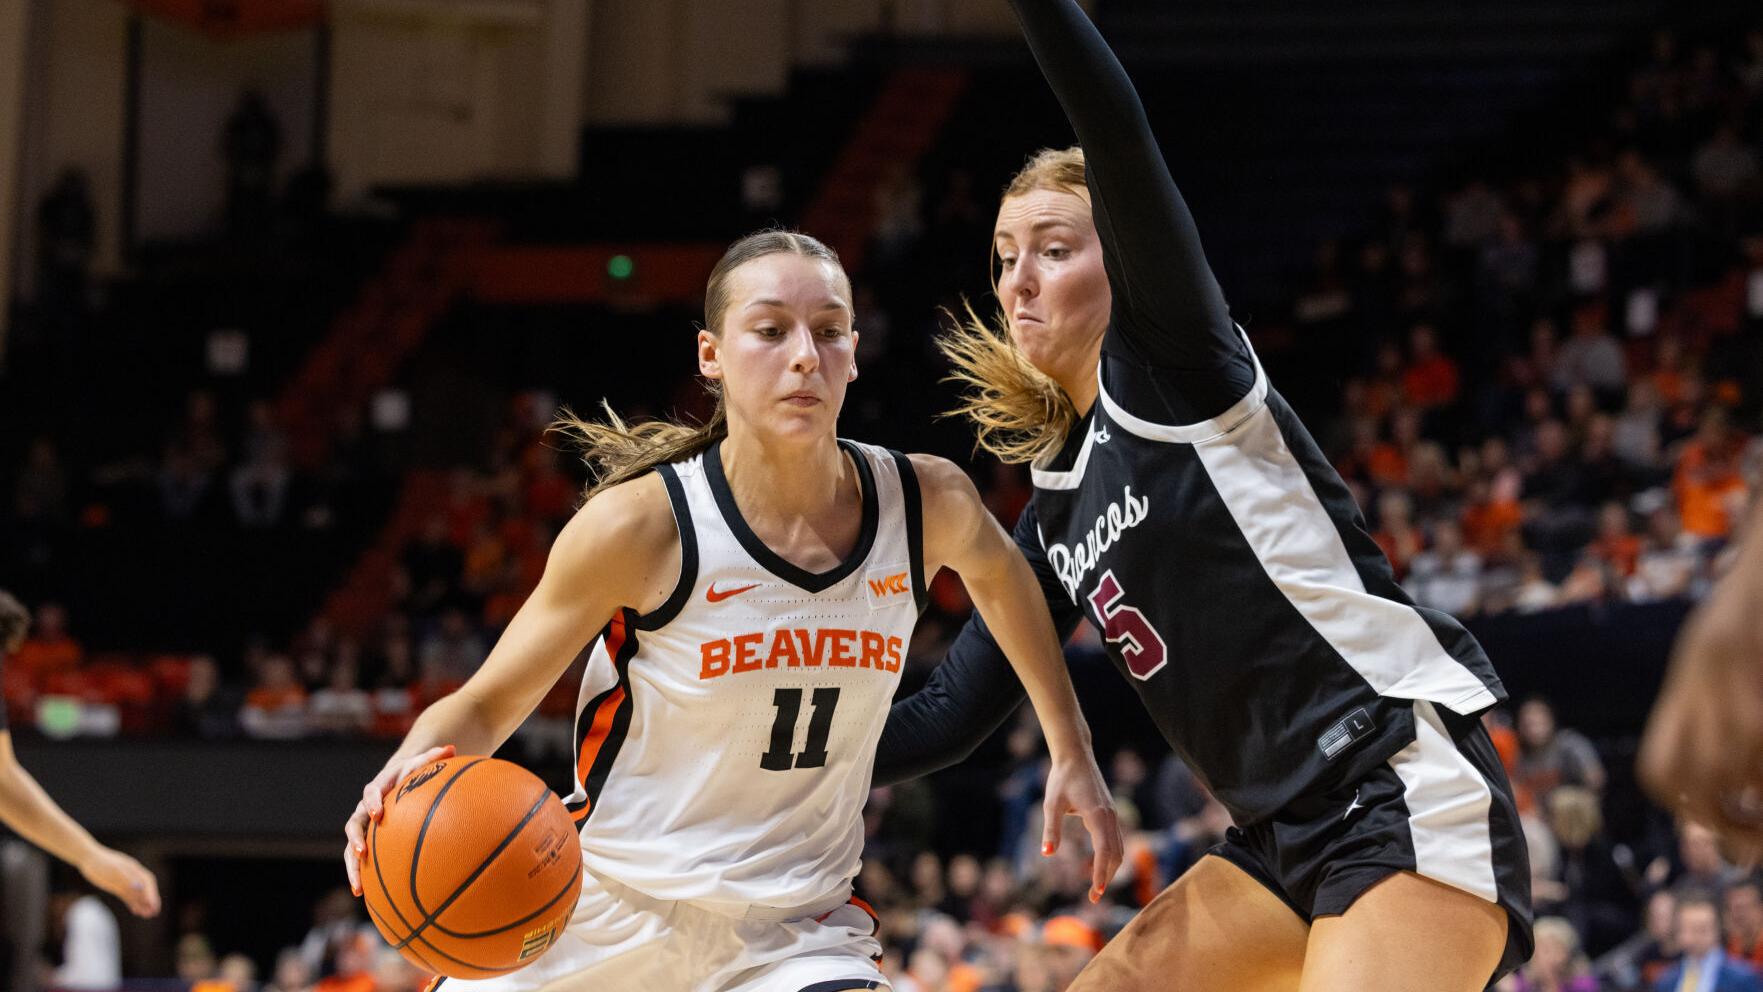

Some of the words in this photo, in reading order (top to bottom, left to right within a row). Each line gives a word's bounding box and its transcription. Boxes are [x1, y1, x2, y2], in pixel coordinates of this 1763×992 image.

[1047, 485, 1149, 606] Broncos
[868, 572, 909, 598] WCC
[699, 628, 903, 680] BEAVERS
[1087, 568, 1168, 682] 5
[760, 687, 841, 771] 11
[1353, 719, 1364, 730] L
